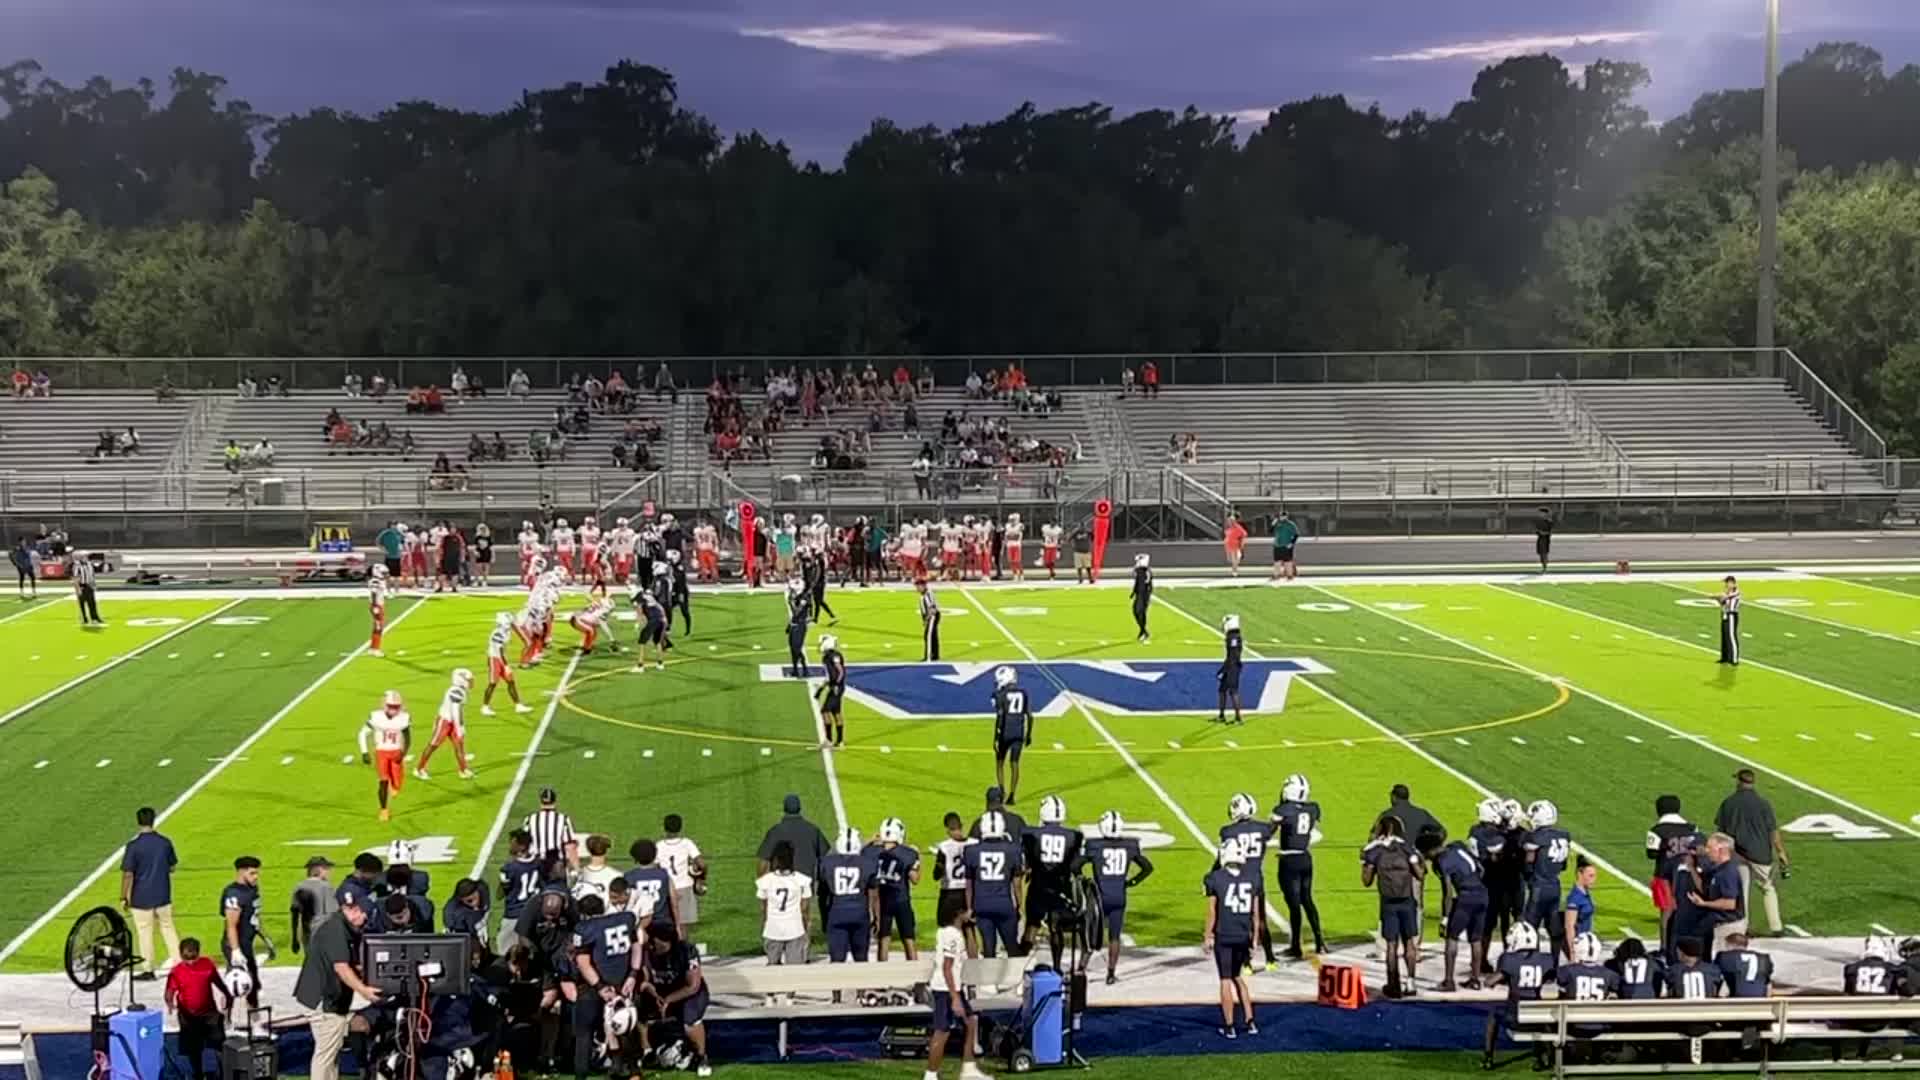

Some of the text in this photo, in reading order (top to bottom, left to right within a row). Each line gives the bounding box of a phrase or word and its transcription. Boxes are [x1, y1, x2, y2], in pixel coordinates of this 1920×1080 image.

[1297, 813, 1310, 835] 8
[1041, 834, 1066, 863] 99
[1102, 848, 1127, 876] 30
[668, 854, 678, 876] 1
[979, 851, 1006, 880] 52
[833, 867, 860, 895] 62
[776, 887, 789, 911] 7
[1223, 882, 1253, 913] 45
[603, 924, 631, 956] 55
[1518, 965, 1543, 988] 81
[1740, 953, 1759, 981] 7
[1856, 968, 1887, 993] 82
[1319, 964, 1353, 1000] 50
